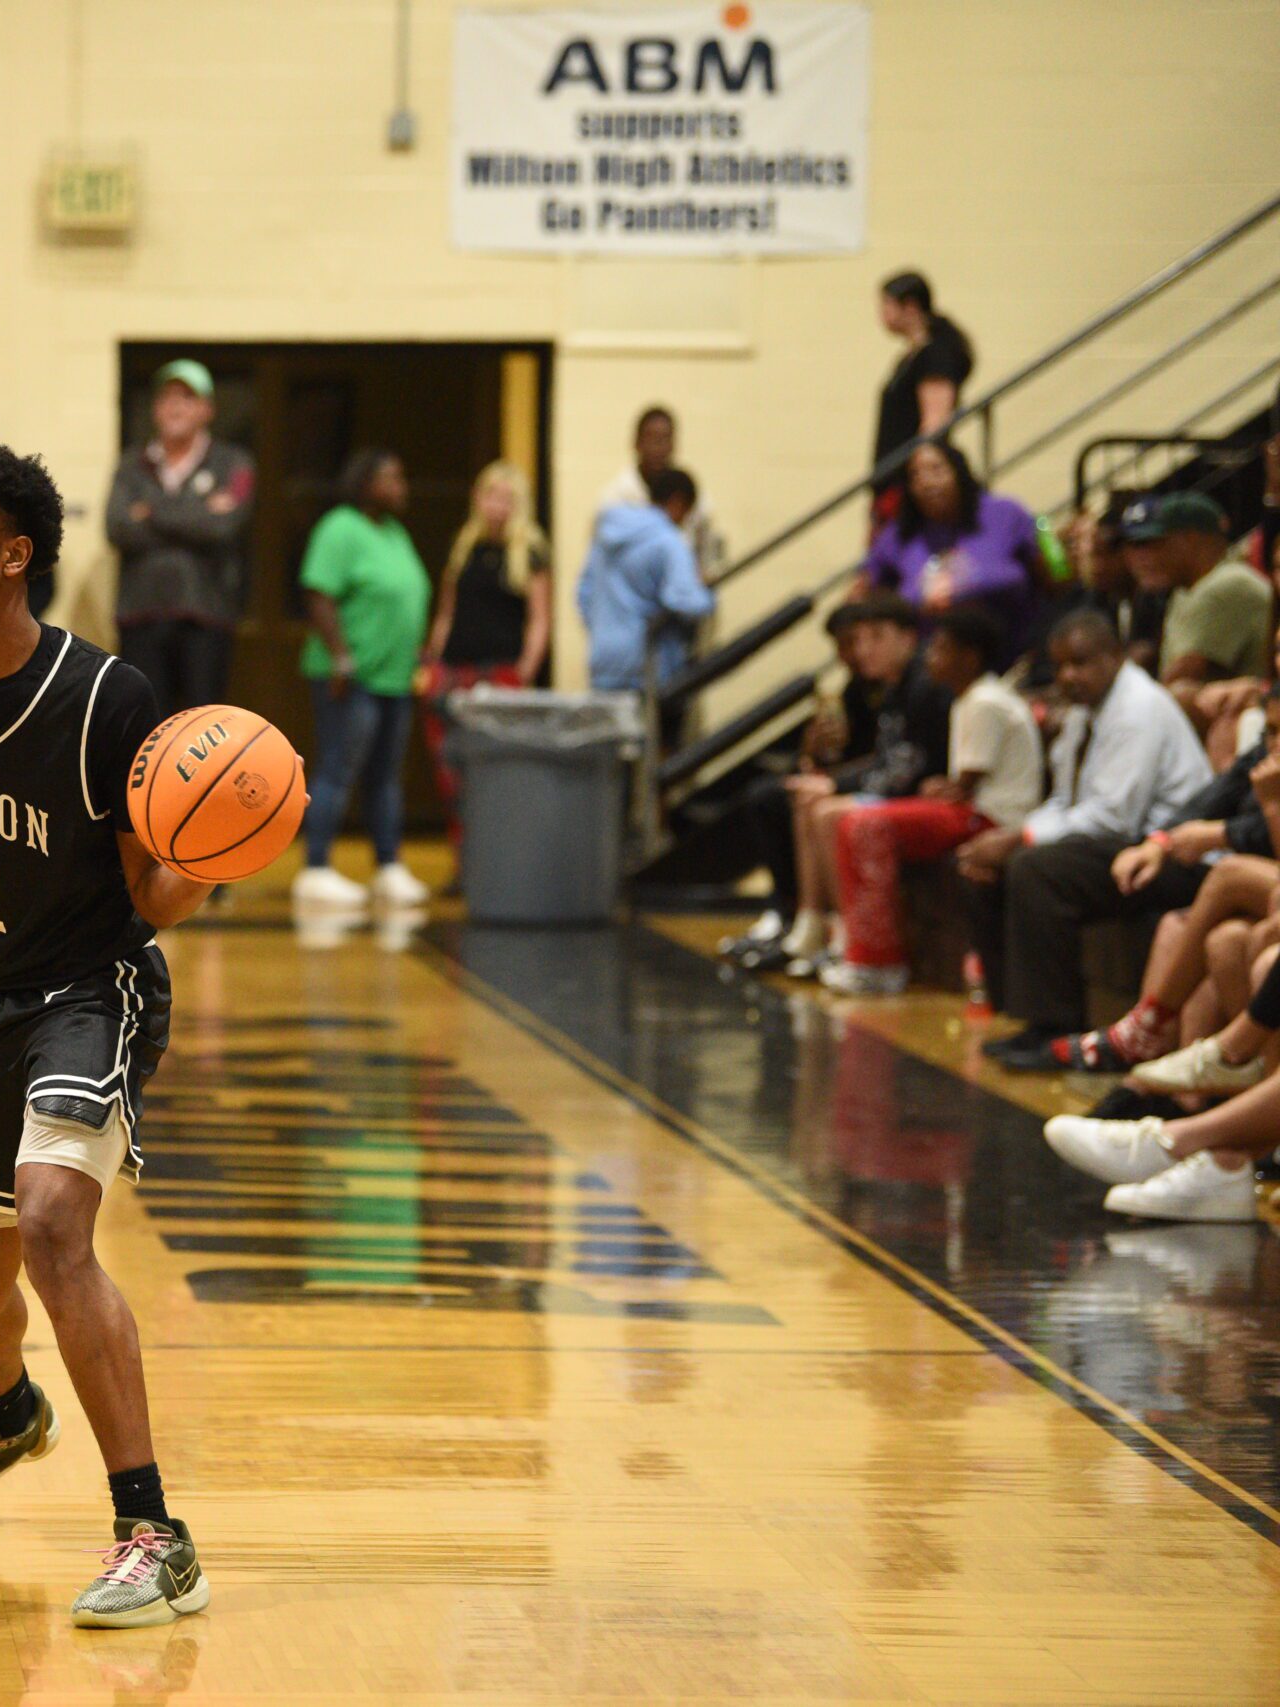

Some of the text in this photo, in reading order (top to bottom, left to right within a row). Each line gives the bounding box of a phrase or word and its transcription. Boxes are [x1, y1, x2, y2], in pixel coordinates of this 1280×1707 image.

[542, 36, 778, 95] ABM
[577, 109, 742, 139] supports
[467, 152, 849, 189] Milton High Athletics
[541, 201, 583, 231] Go
